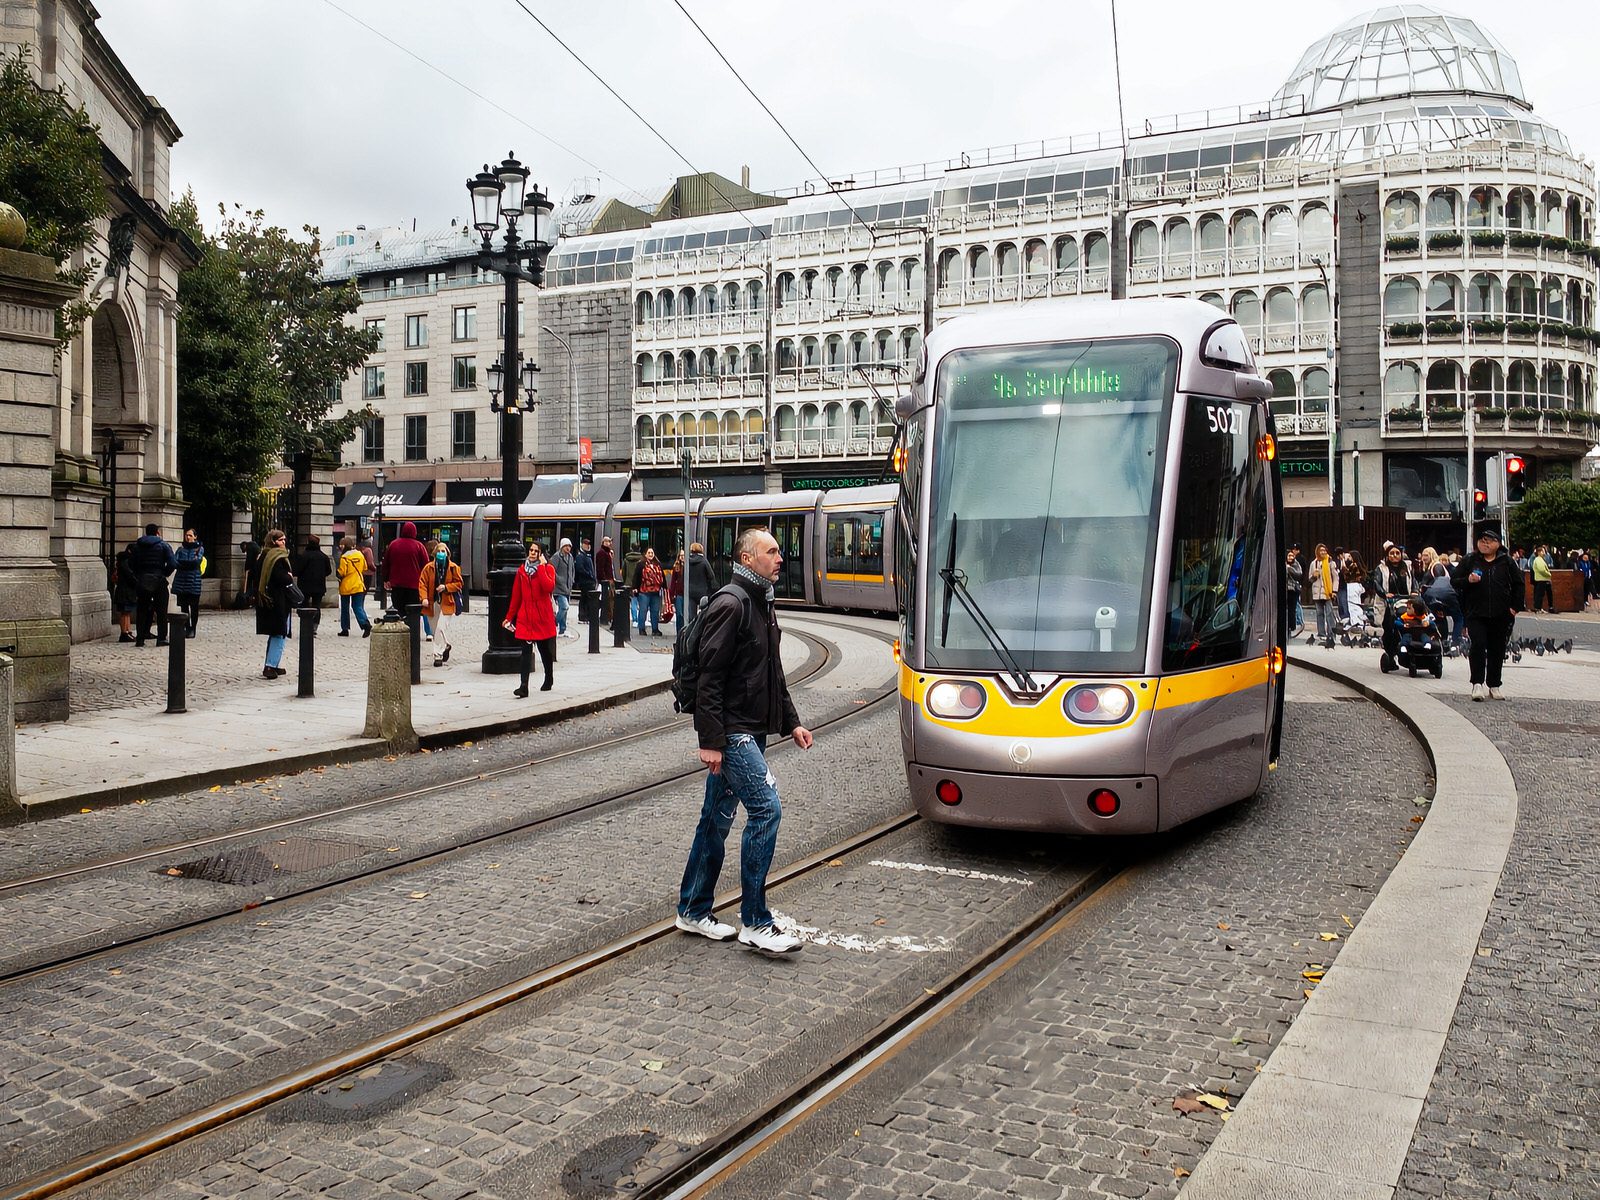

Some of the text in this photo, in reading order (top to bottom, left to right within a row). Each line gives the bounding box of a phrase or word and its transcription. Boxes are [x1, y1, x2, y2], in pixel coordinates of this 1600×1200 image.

[1206, 405, 1243, 435] 5027
[1281, 462, 1324, 473] ETTON.
[791, 479, 821, 488] UNITED
[821, 478, 854, 488] COLORS
